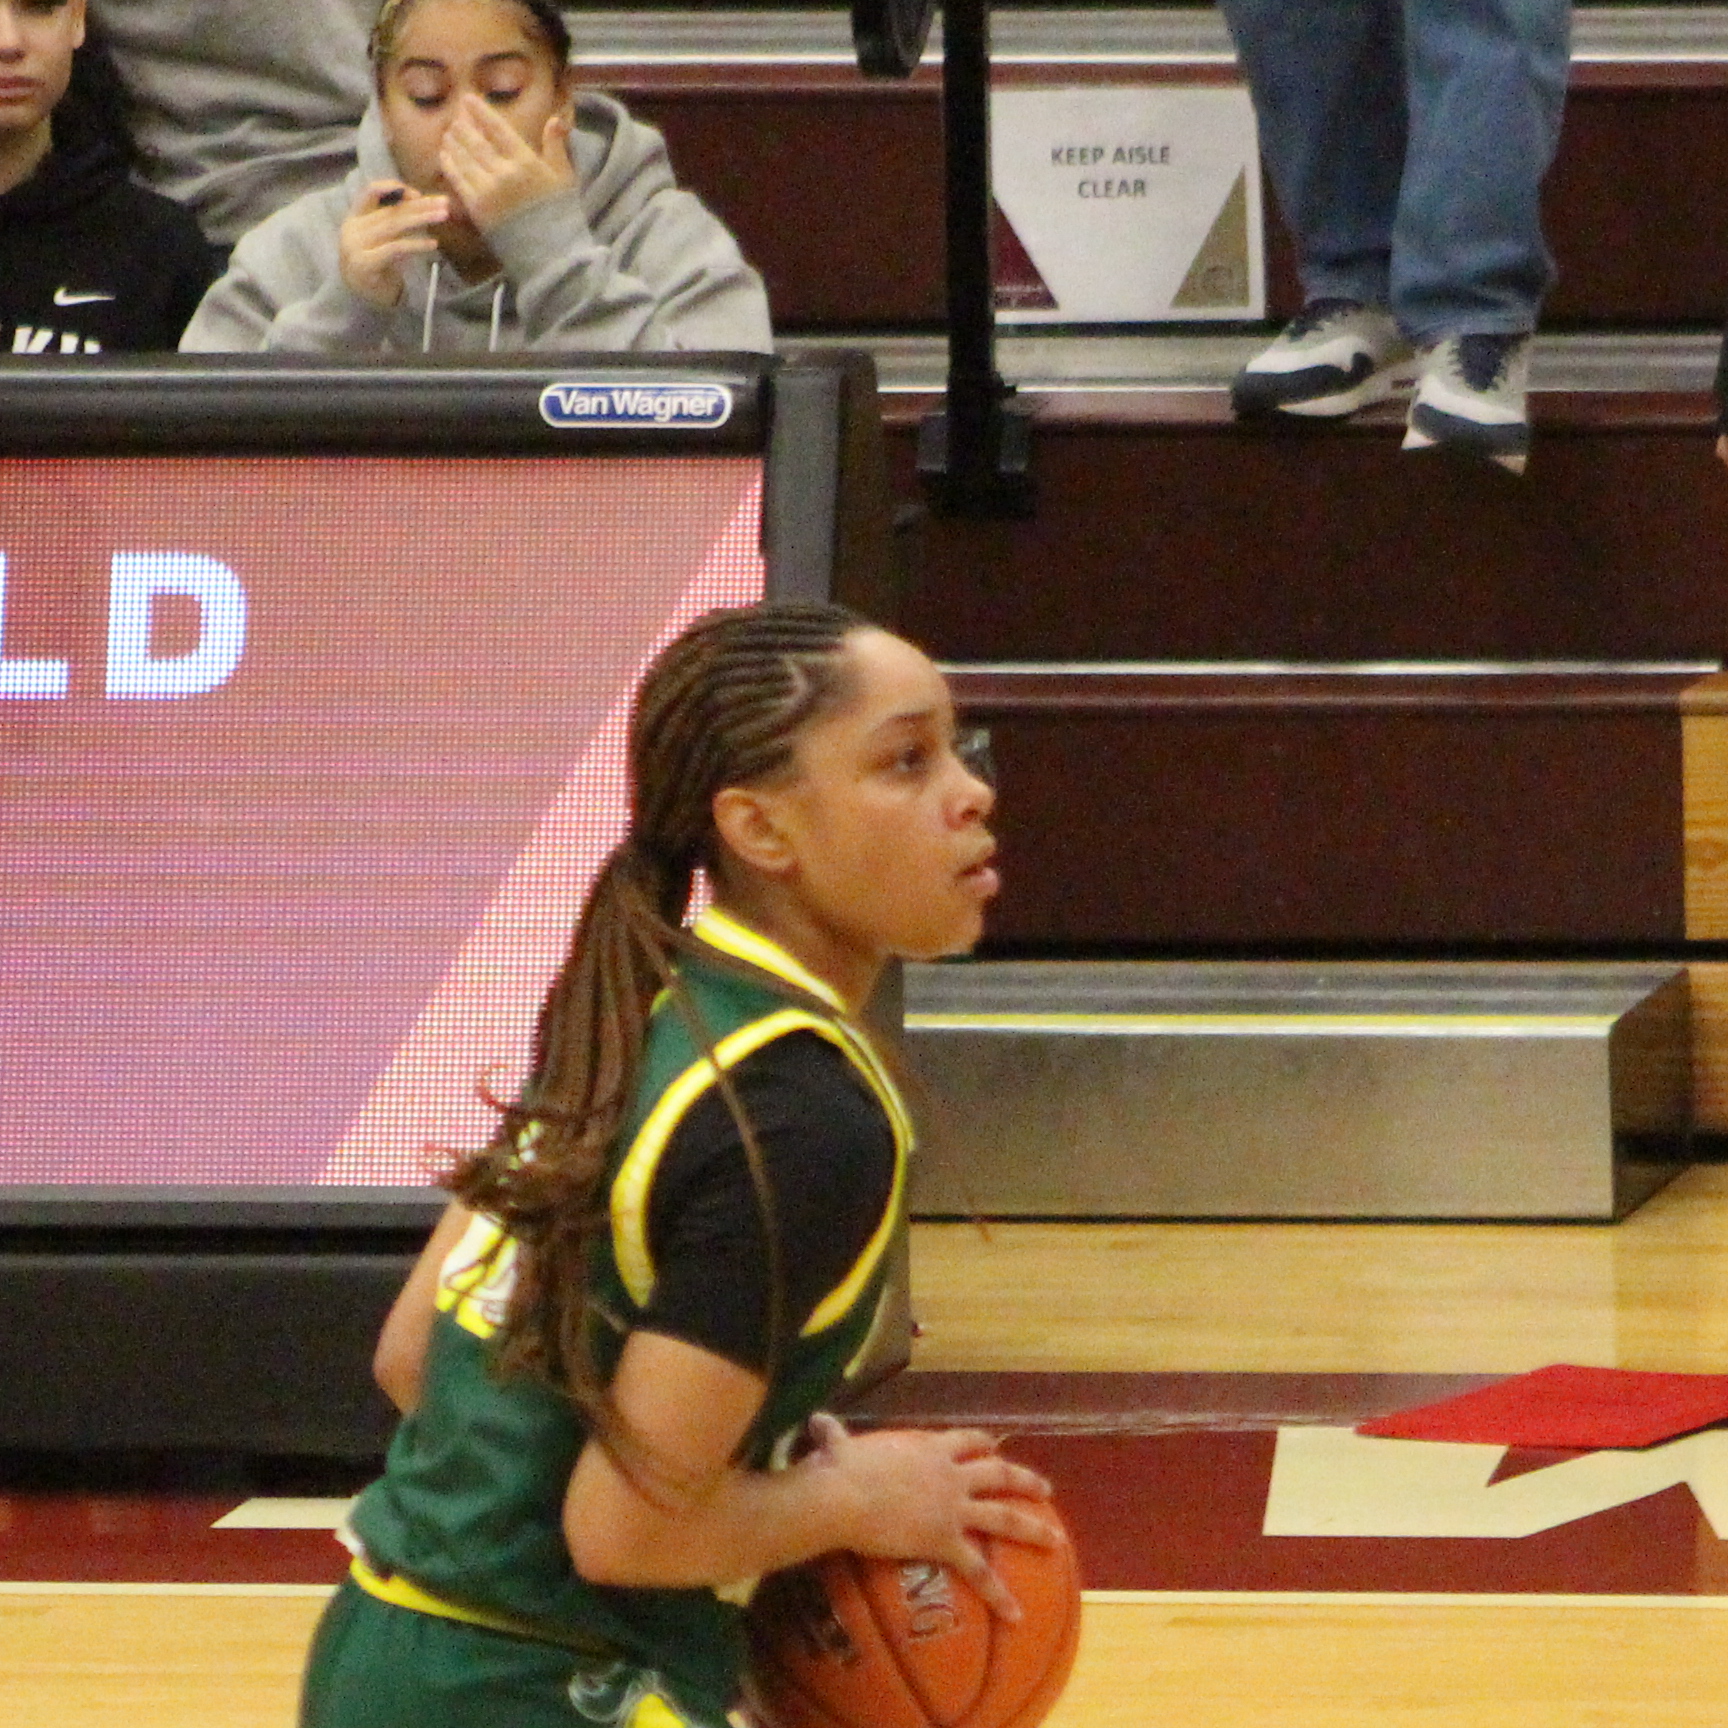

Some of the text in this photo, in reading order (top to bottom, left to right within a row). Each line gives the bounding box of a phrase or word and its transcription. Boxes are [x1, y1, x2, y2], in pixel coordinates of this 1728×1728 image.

[1050, 146, 1171, 166] KEEP AISLE
[1077, 179, 1147, 199] CLEAR
[558, 390, 719, 422] Van Wagner
